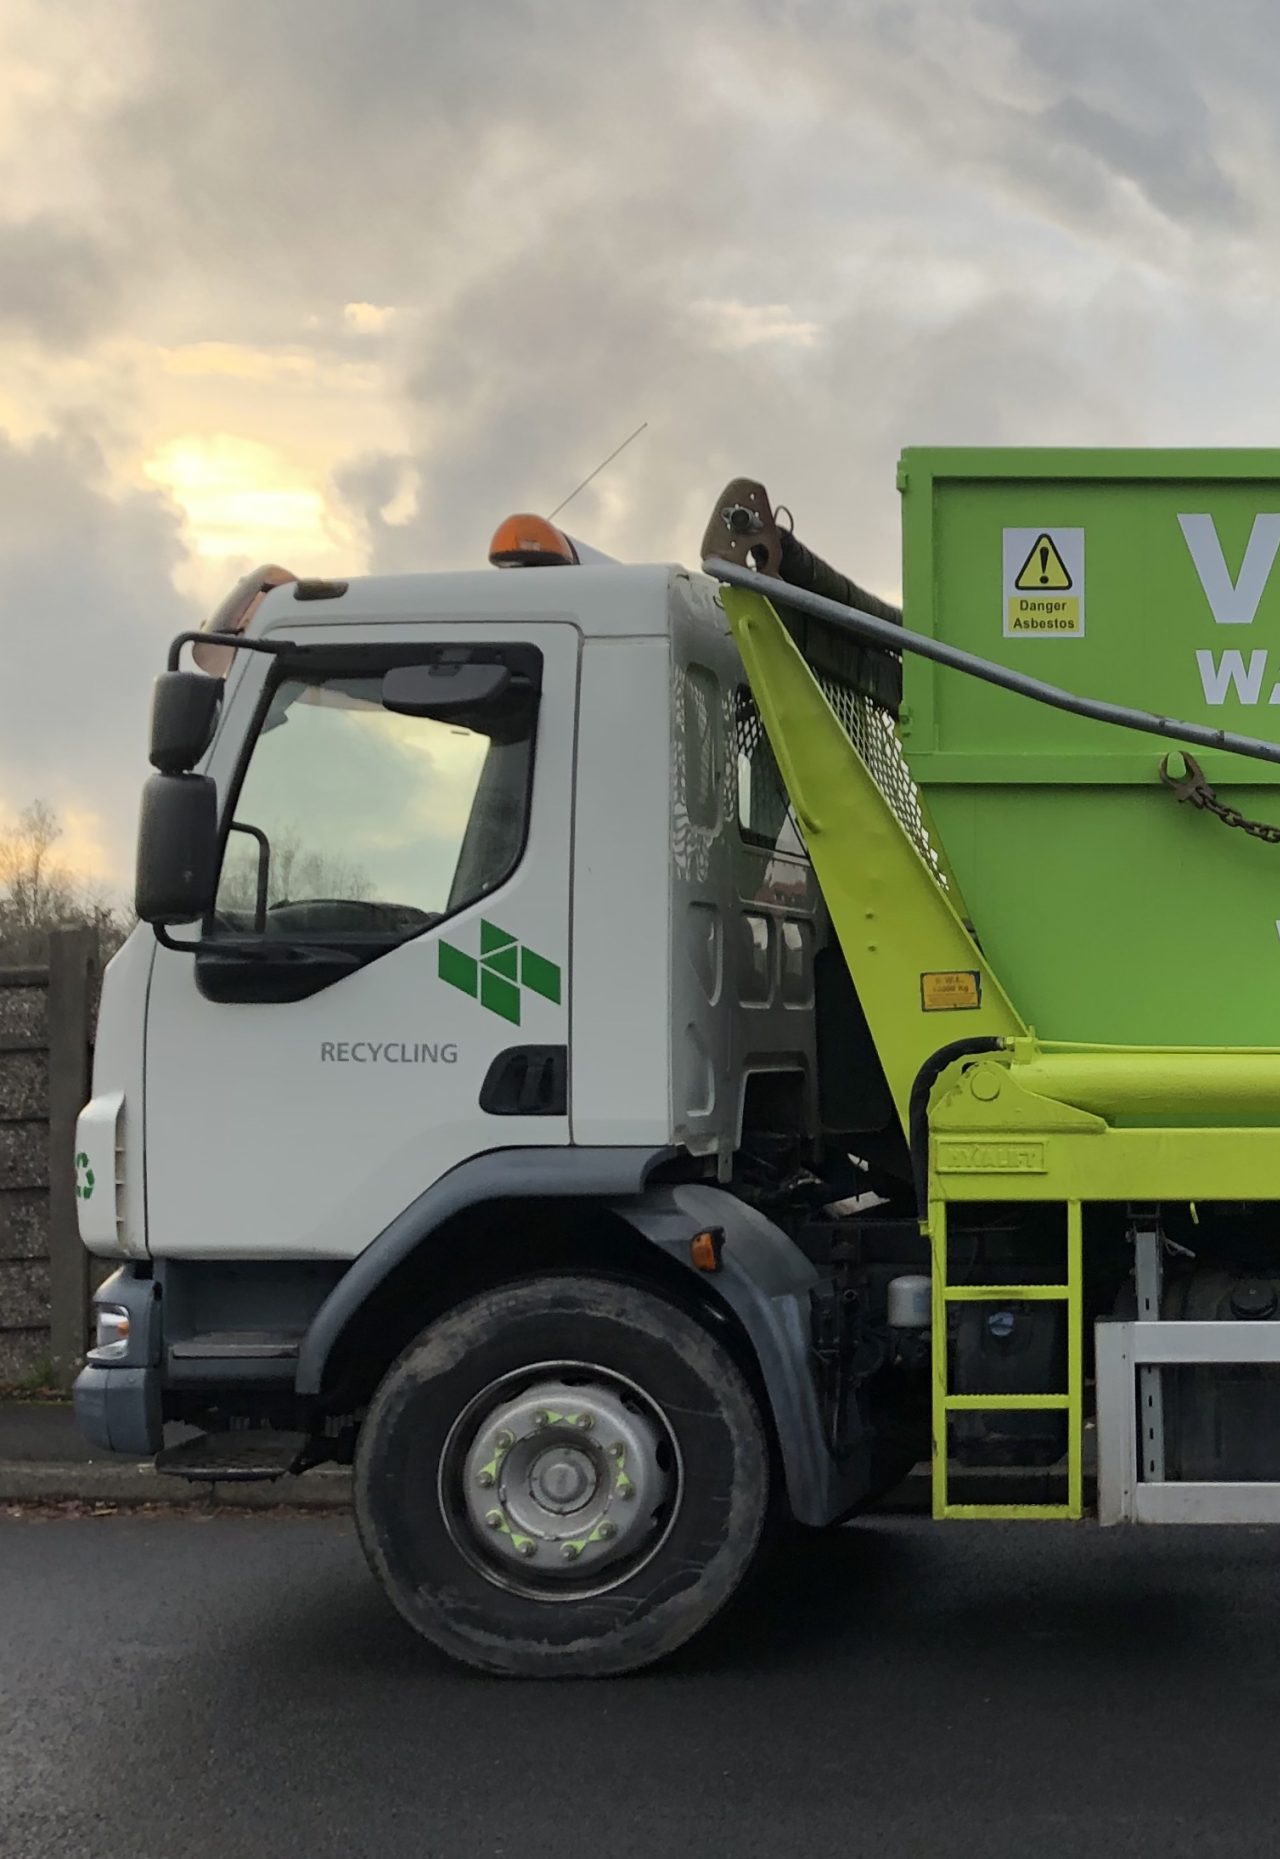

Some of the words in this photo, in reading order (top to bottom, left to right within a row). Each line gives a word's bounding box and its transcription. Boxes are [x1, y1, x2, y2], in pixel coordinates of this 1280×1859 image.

[1019, 599, 1067, 613] Danger
[1013, 617, 1075, 629] Asbestos
[320, 1041, 458, 1063] RECYCLING
